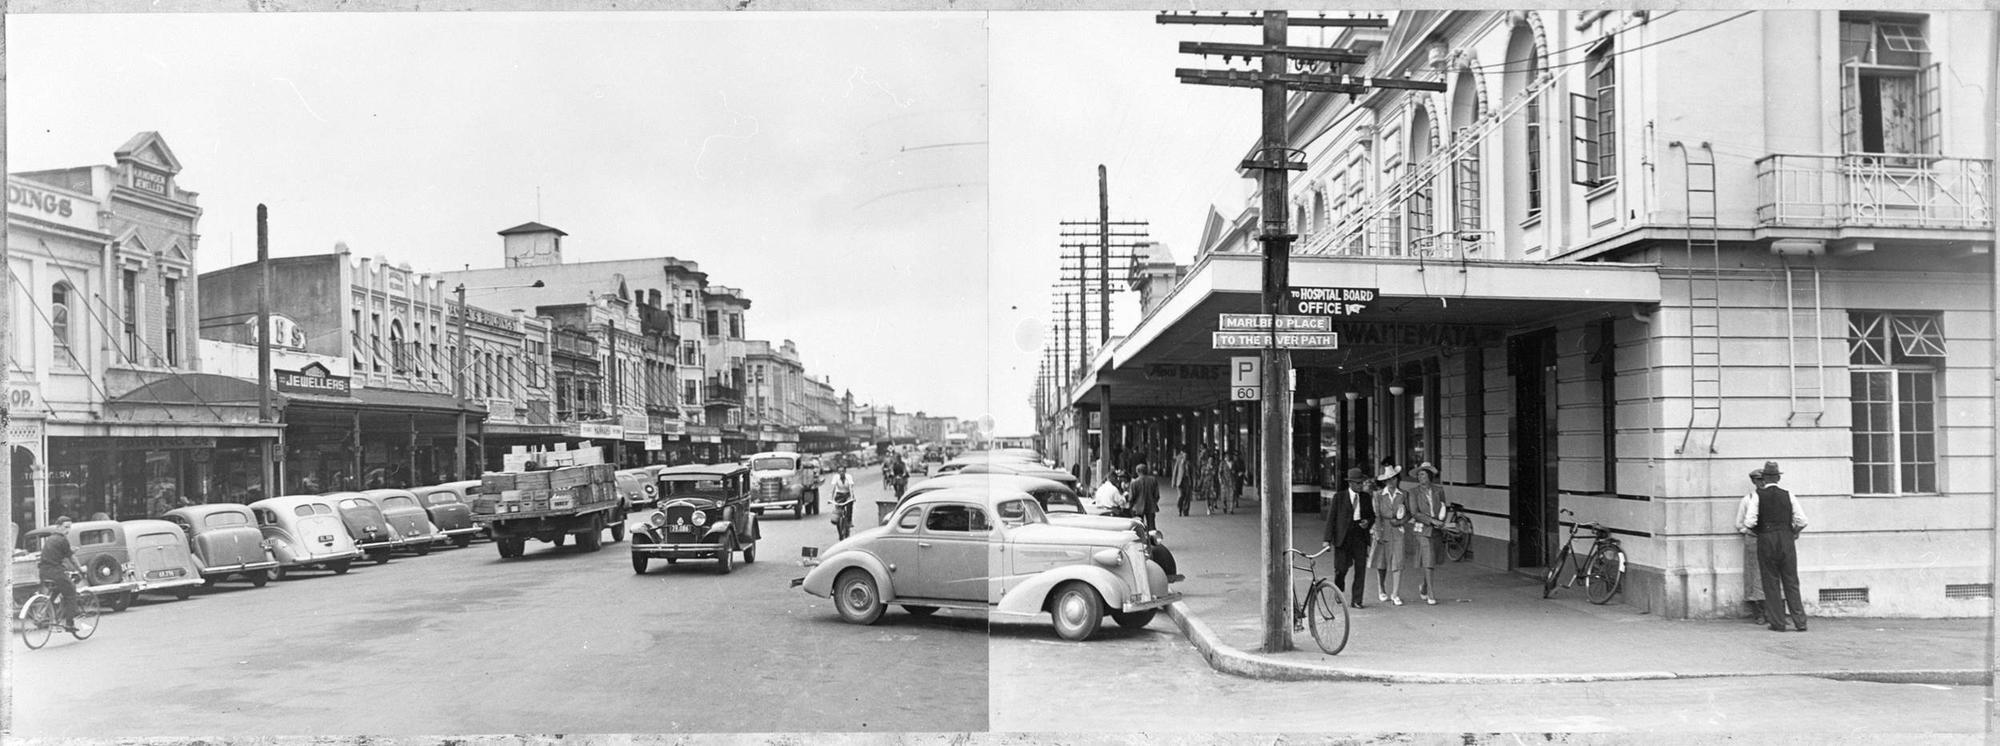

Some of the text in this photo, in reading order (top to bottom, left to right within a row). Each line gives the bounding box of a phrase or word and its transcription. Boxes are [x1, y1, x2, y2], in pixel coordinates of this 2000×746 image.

[1300, 288, 1342, 301] HOSPITAL
[1343, 289, 1374, 302] BOARD
[1298, 301, 1342, 315] OFFICE
[1286, 318, 1325, 328] PLACE
[1221, 335, 1331, 345] TO THE RVER PATH
[1342, 323, 1478, 346] WAITEMATA
[1238, 361, 1253, 382] P
[286, 375, 345, 391] JEWELLERS
[1237, 388, 1254, 399] 60
